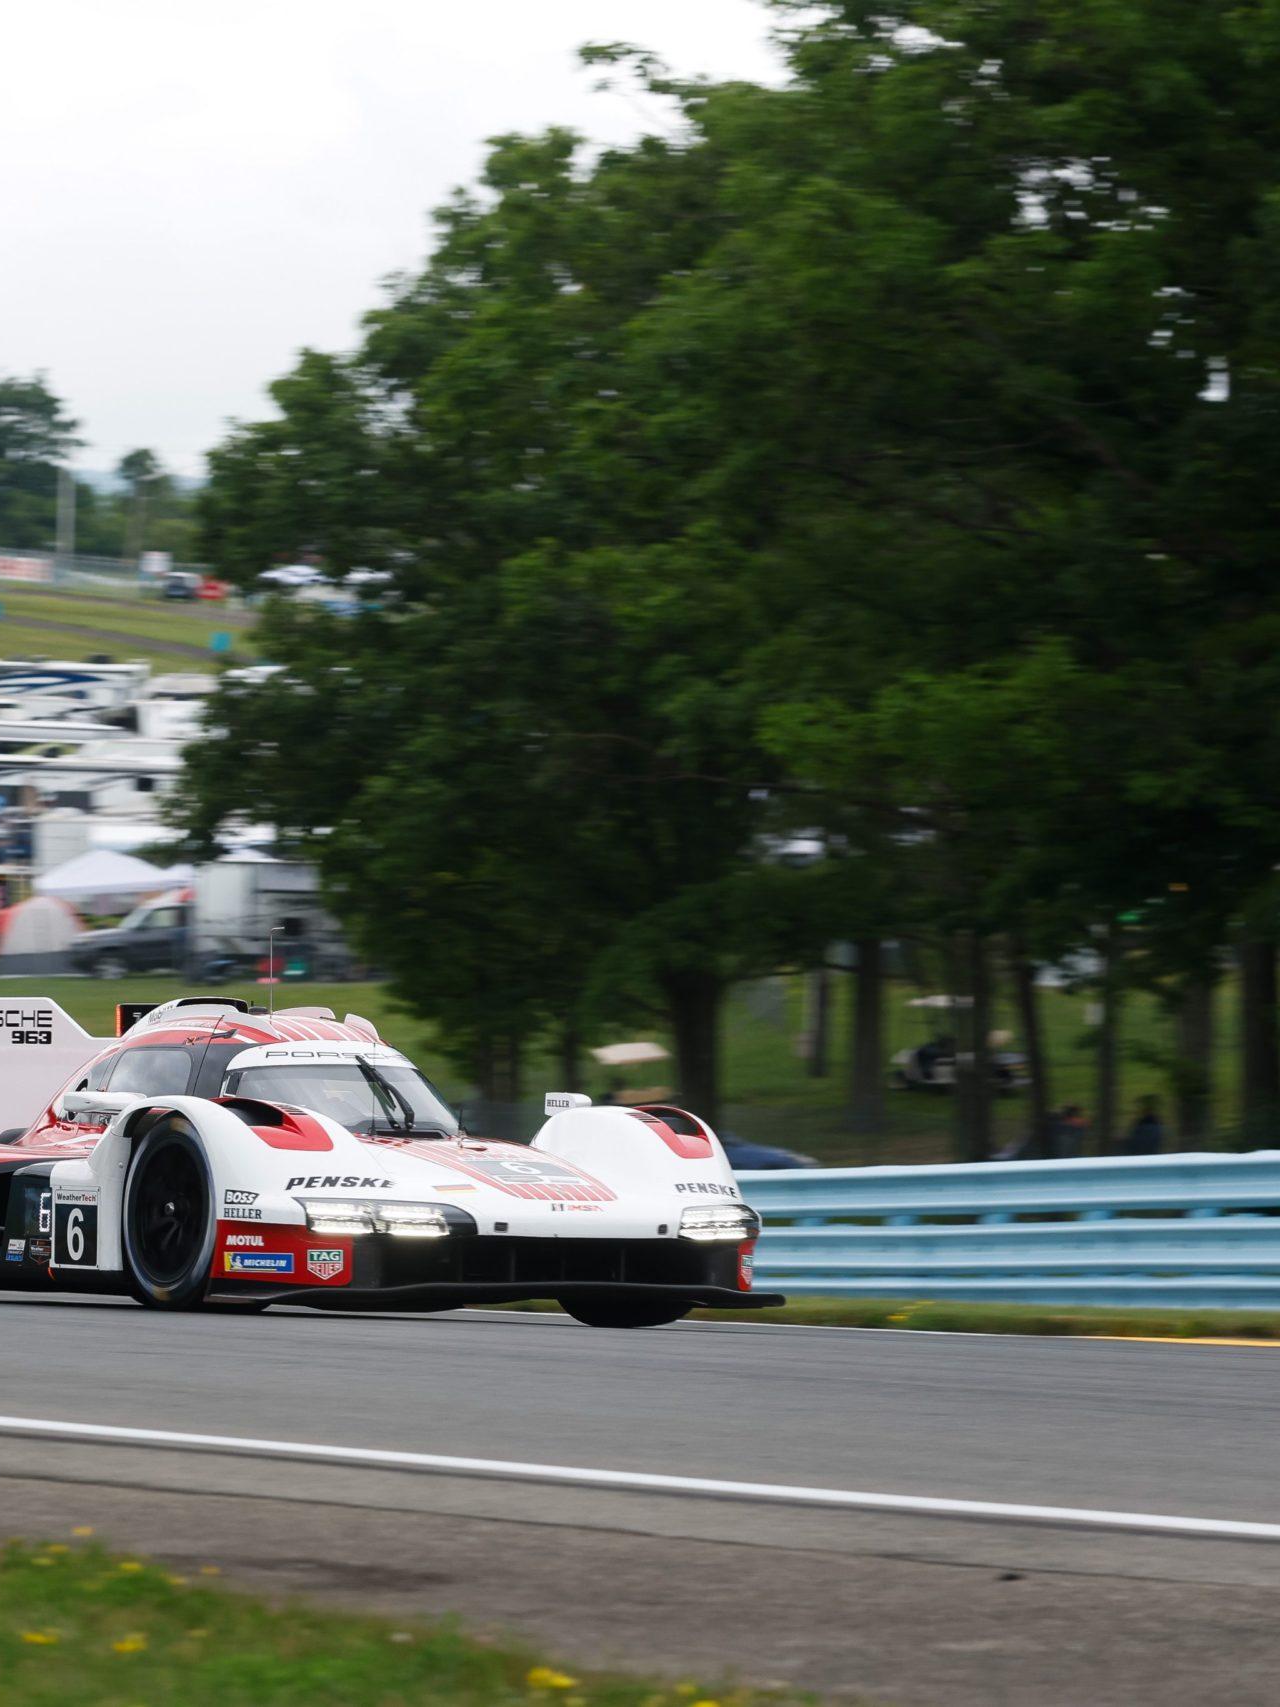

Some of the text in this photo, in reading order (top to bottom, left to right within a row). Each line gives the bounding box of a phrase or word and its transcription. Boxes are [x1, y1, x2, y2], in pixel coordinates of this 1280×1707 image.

[12, 1031, 51, 1044] 963
[547, 1099, 569, 1108] HELLER
[500, 1161, 542, 1175] 6
[285, 1176, 396, 1191] PENSKE
[674, 1183, 737, 1198] PENSKE
[57, 1193, 96, 1201] WeatherTech
[226, 1191, 256, 1203] BOSS
[224, 1207, 262, 1219] HELLER
[67, 1207, 84, 1261] 6
[226, 1235, 264, 1247] MOTUL
[312, 1252, 340, 1261] TAG
[243, 1259, 287, 1267] MICHELIN
[310, 1262, 341, 1276] HEUER
